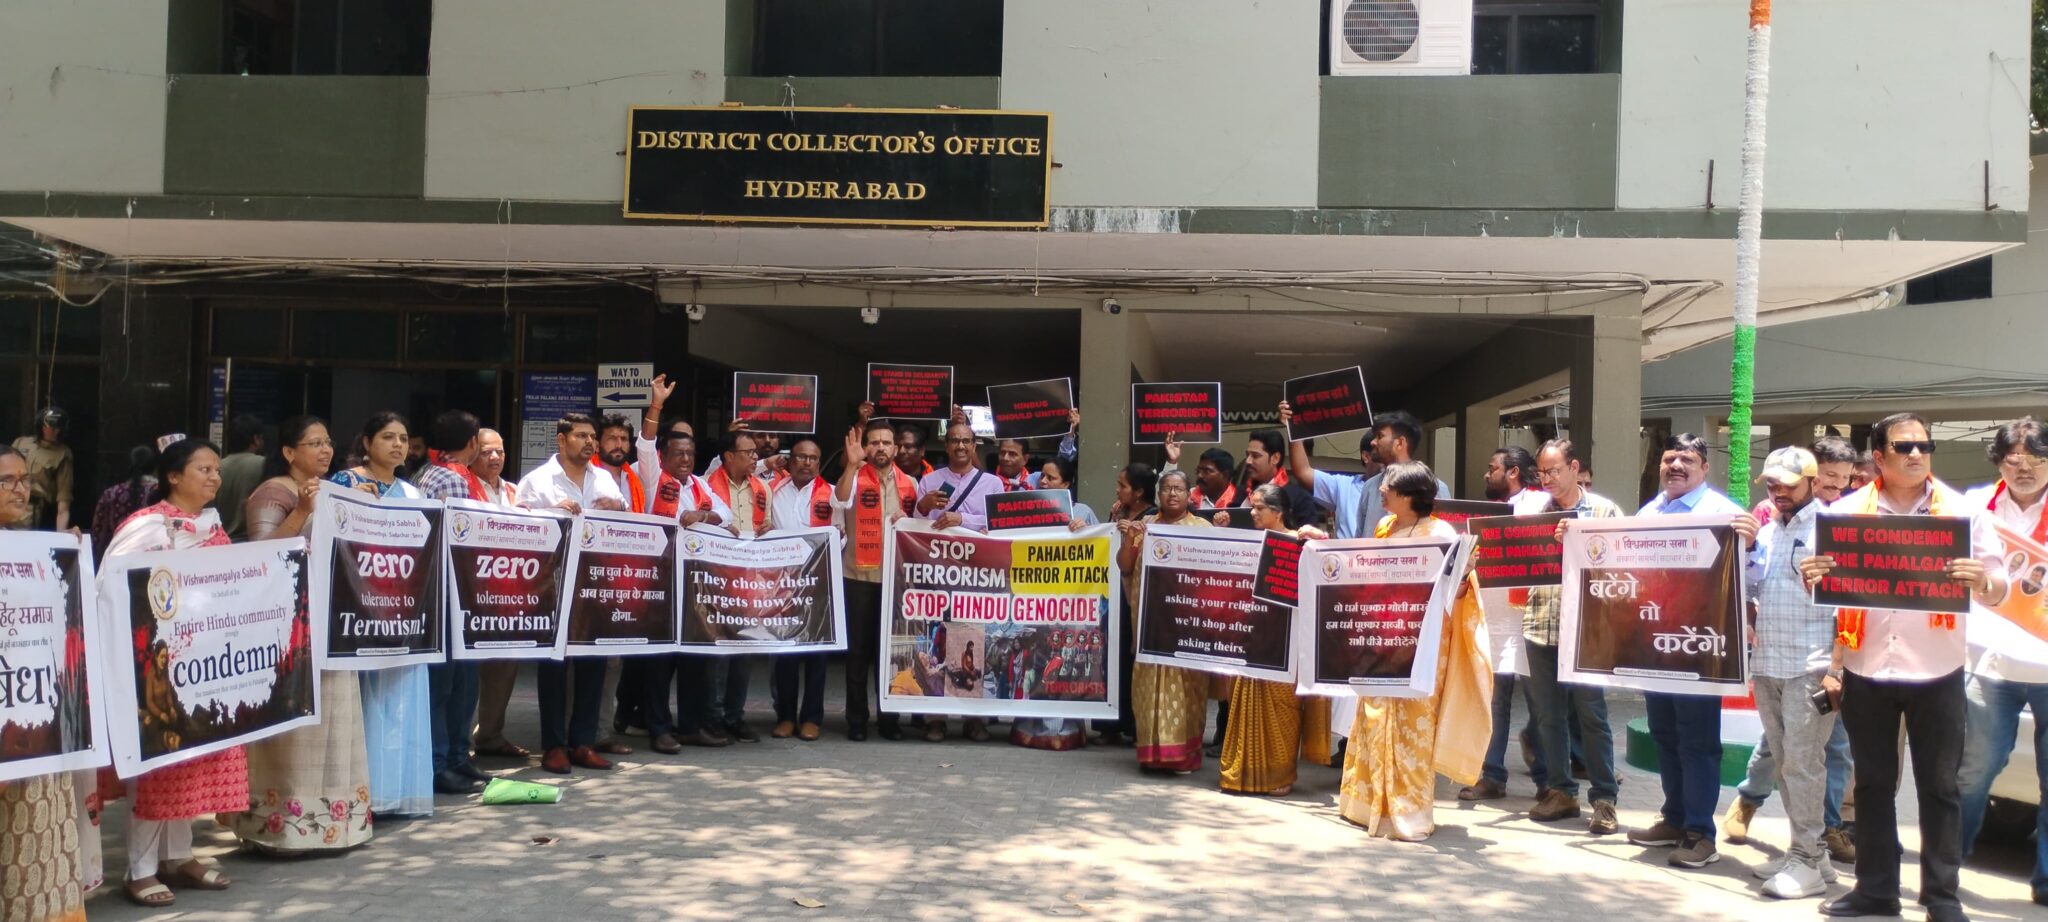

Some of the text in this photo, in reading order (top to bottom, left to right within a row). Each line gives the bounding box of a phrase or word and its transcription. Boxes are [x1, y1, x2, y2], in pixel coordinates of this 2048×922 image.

[637, 130, 1040, 157] DISTRICT COLLECTOR'S OFFICE
[744, 180, 926, 200] HYDERABAD
[611, 368, 639, 377] WAY TO
[598, 378, 631, 388] MEETING
[633, 378, 652, 388] HALL
[748, 384, 756, 393] A
[785, 385, 804, 395] DAY
[741, 397, 811, 408] NEVER FORGET
[1013, 400, 1049, 410] HINDUS
[1144, 392, 1208, 403] PAKISTAN
[996, 412, 1033, 422] SHOULD
[1136, 407, 1217, 418] TERRORISTS
[1140, 423, 1212, 433] MURDABAD
[997, 500, 1060, 512] PAKISTAN
[396, 519, 416, 528] Sabha
[991, 512, 1069, 527] TERRORISTS
[526, 524, 541, 534] सभा
[1482, 527, 1501, 540] WE
[1832, 527, 1953, 546] WE CONDEMN
[715, 542, 795, 556] Vishwamangalya Sabha
[929, 539, 975, 560] STOP
[1622, 535, 1688, 549] विश्वमांगल्य सभा
[1027, 545, 1094, 562] PAHALGAM
[1183, 545, 1260, 558] Vishwamangalya Sabh
[1478, 546, 1502, 559] THE
[358, 551, 415, 579] zero
[476, 555, 539, 580] zero
[1356, 554, 1418, 567] विश्वमांगल्य सभा
[1863, 552, 1951, 572] PAHALGA
[183, 566, 262, 587] Vishwamangalya Sabha
[589, 566, 605, 580] चुन
[606, 566, 621, 581] चुन
[623, 564, 633, 577] के
[903, 563, 1005, 588] TERRORISM
[1012, 566, 1109, 584] TERROR ATTACK
[1477, 562, 1562, 579] TERROR ATTA
[690, 571, 819, 589] They chose their
[1176, 573, 1255, 590] They shoot afte
[1589, 572, 1639, 599] बटेंगे
[1821, 576, 1965, 599] TERROR ATTACK
[361, 591, 415, 607] tolerance to
[476, 590, 539, 605] tolerance to
[579, 586, 665, 604] अब चुन चुन के मारना
[696, 591, 813, 608] targets now we
[1165, 594, 1268, 613] asking your religion
[19, 606, 53, 625] समाज
[611, 608, 637, 622] होगा...
[905, 592, 1098, 622] STOP HINDU GENOCIDE
[1334, 601, 1408, 615] वो धर्म पूछकर गोली
[1639, 600, 1661, 621] तो
[174, 603, 287, 637] Entire Hindu community
[340, 612, 426, 636] Terrorism!
[460, 609, 555, 631] Terrorism!
[706, 612, 804, 627] choose ours.
[1175, 616, 1254, 633] we'll shop after
[1326, 621, 1337, 630] हम
[1340, 619, 1353, 630] धर्म
[1355, 621, 1380, 633] पूछकर
[1178, 637, 1246, 654] asking theirs.
[1349, 636, 1364, 646] सभी
[1652, 625, 1727, 657] कटेंगे!
[174, 641, 278, 688] condemn
[1044, 681, 1105, 695] TERRORISTS
